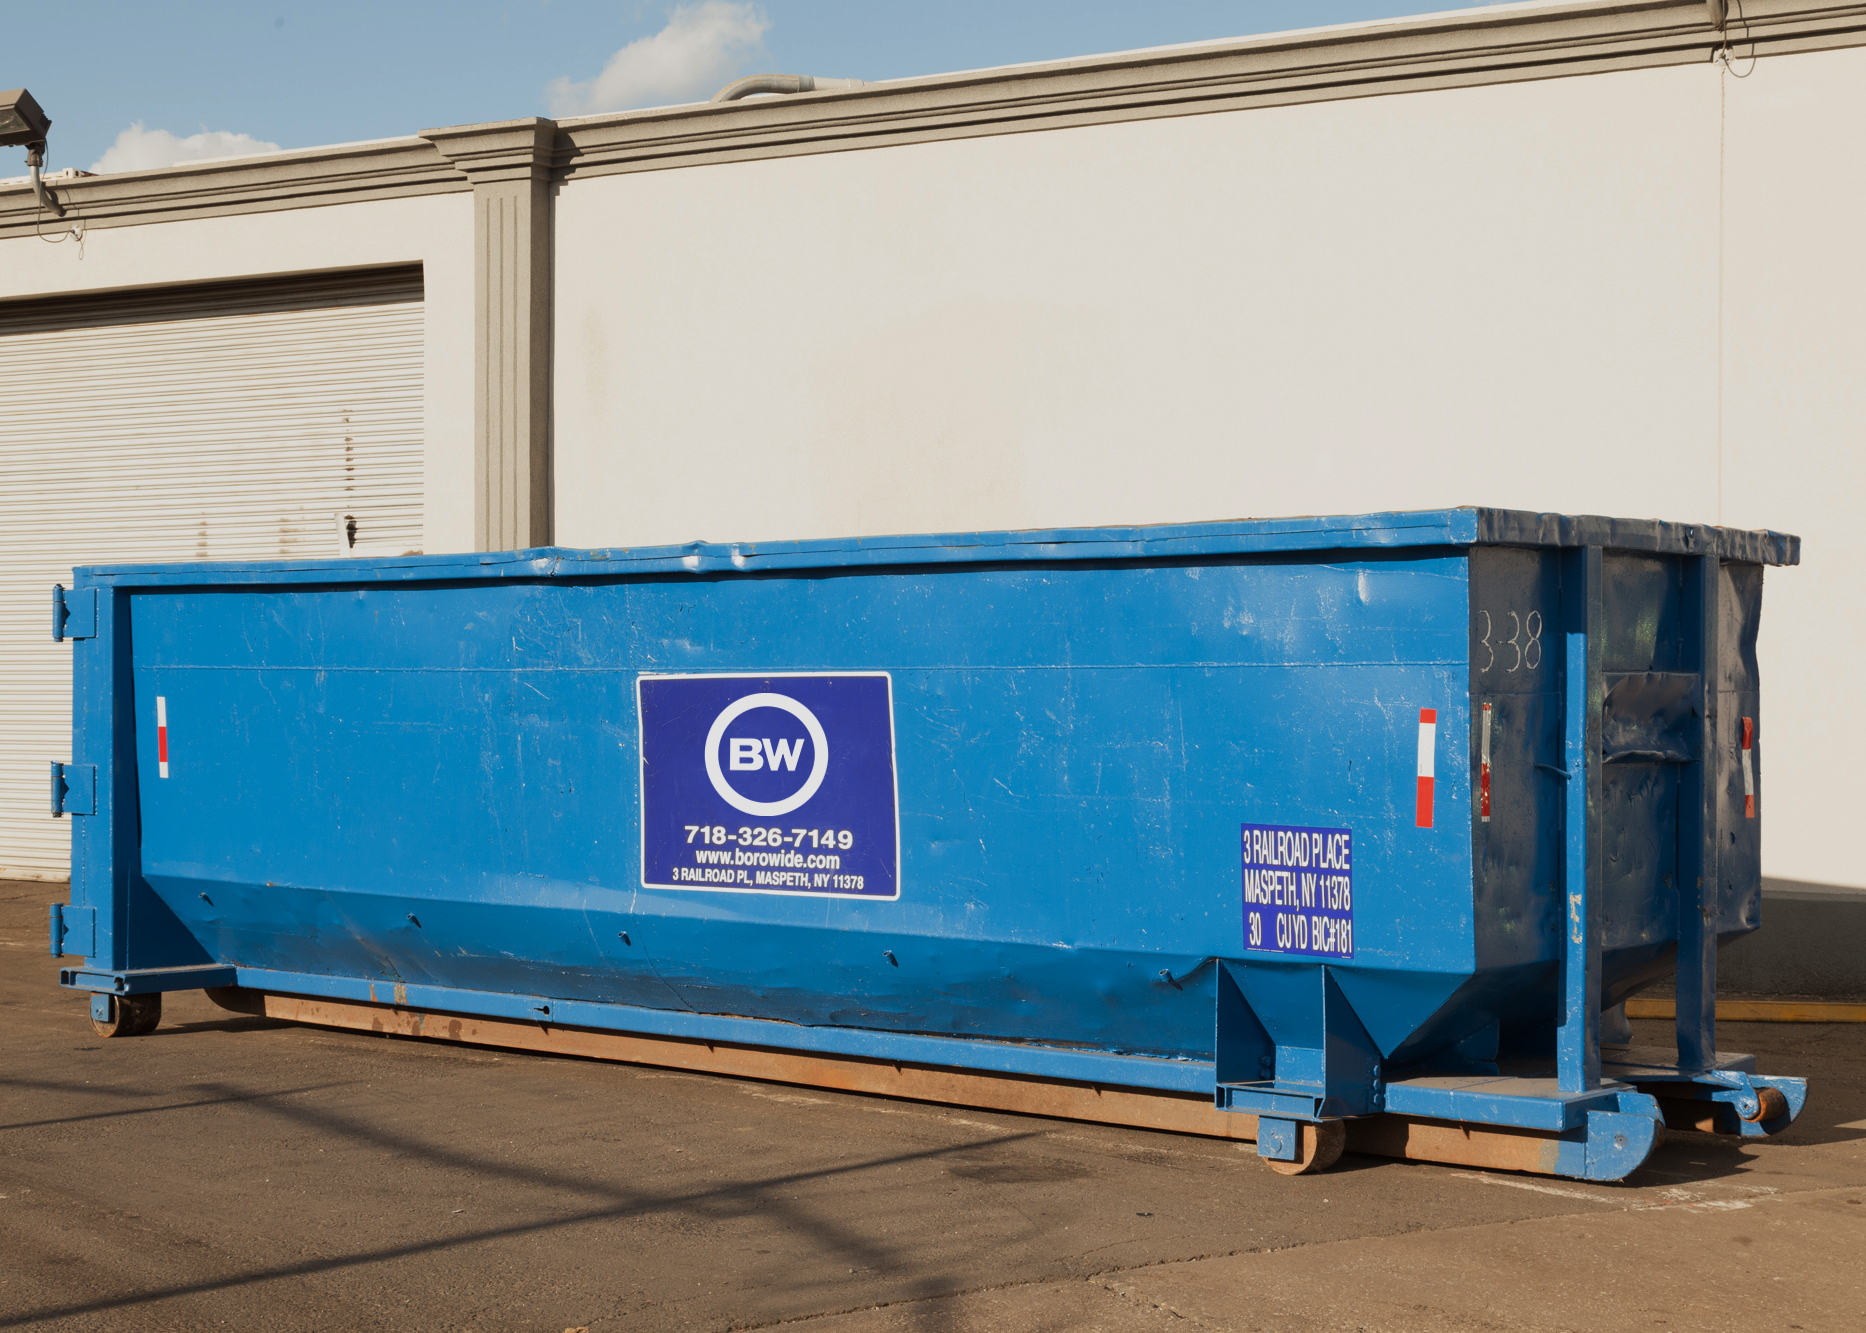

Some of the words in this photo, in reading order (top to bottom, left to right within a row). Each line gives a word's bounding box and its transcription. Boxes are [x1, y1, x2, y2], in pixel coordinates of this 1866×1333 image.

[730, 738, 805, 772] BW
[684, 825, 853, 850] 718-326-7149
[1243, 829, 1251, 864] 3
[1252, 829, 1310, 868] RAILROAD
[1312, 832, 1350, 870] PLACE
[696, 848, 840, 870] www.borowide.com
[672, 868, 679, 881] 3
[681, 868, 735, 884] RAILROAD
[736, 870, 753, 887] PL,
[755, 871, 811, 890] MASPETH,
[813, 874, 829, 888] NY
[833, 875, 864, 890] 11378
[1244, 868, 1300, 912] MASPETH,
[1301, 872, 1317, 908] NY
[1319, 874, 1351, 911] 11378
[1248, 911, 1262, 946] 30
[1311, 915, 1352, 954] BIC#181
